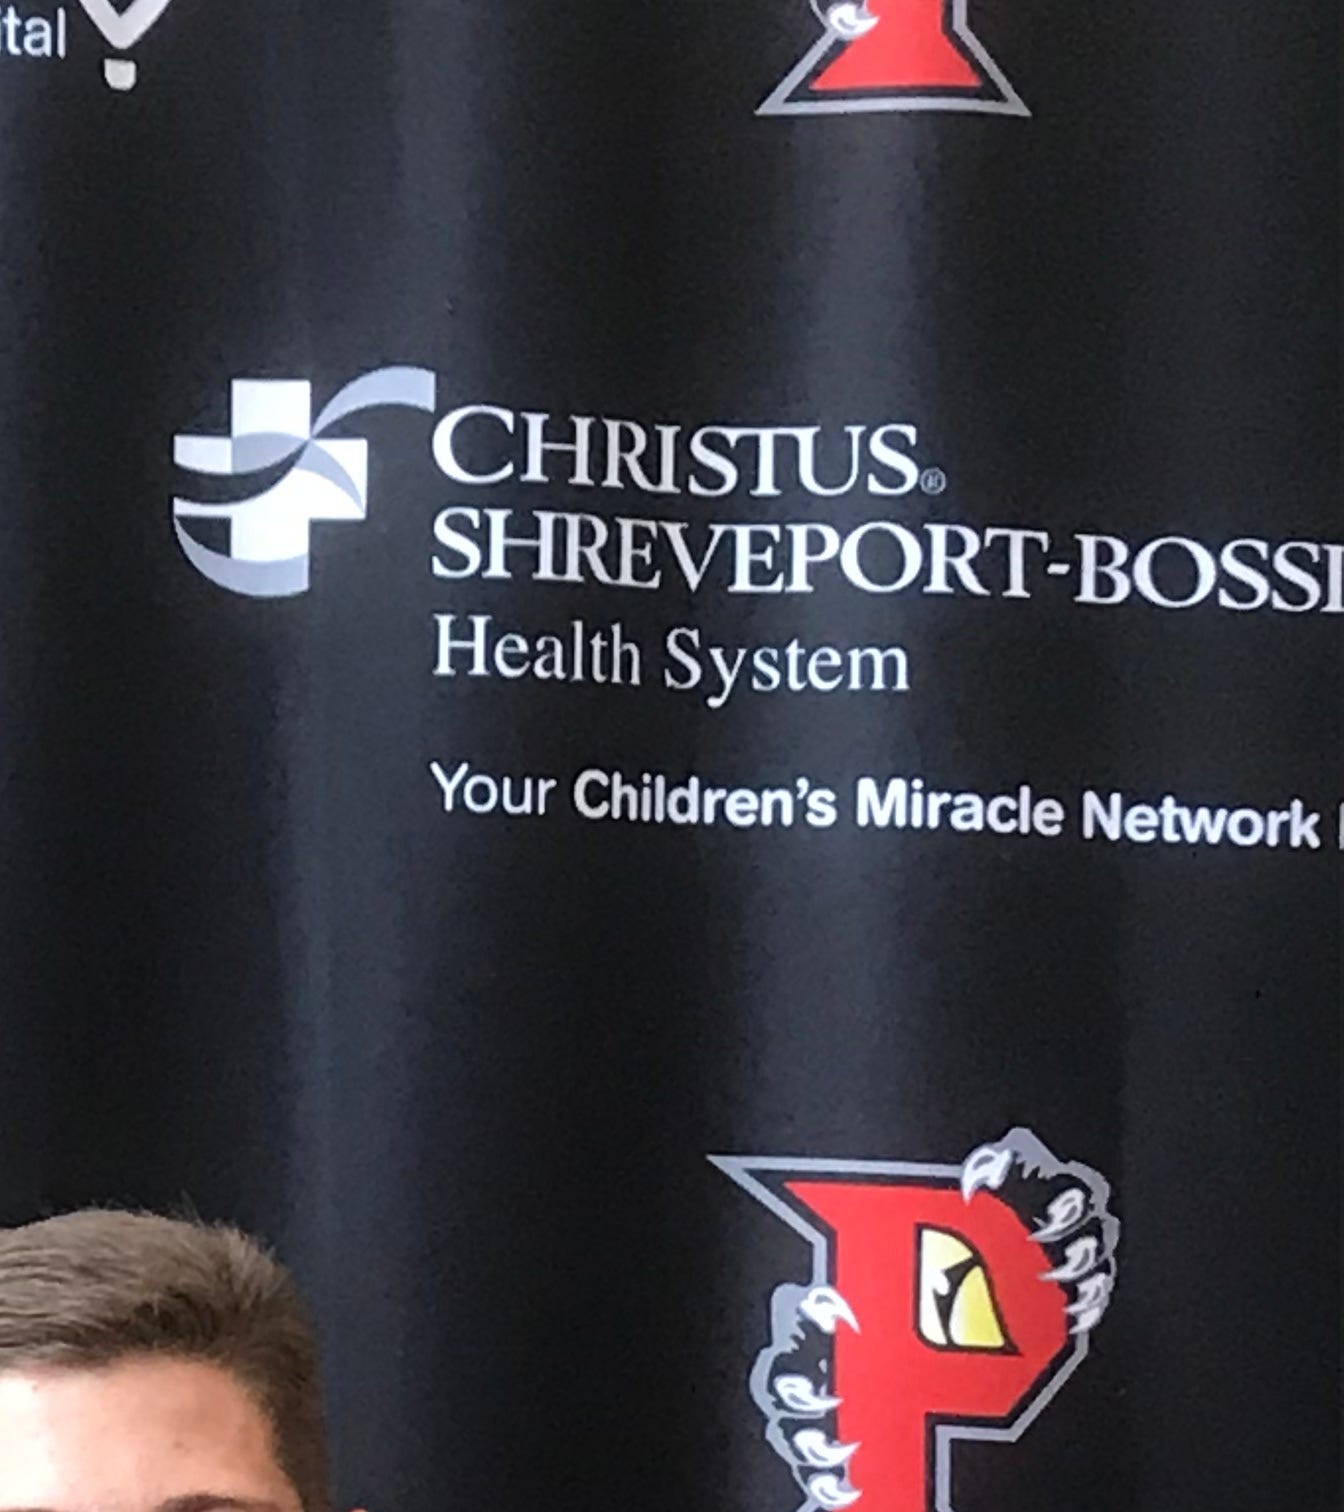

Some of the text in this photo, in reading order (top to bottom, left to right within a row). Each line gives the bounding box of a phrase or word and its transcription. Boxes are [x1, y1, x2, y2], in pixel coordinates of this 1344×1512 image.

[431, 613, 911, 709] Health System
[429, 760, 558, 816] Your
[572, 768, 839, 828] Children's
[856, 776, 1065, 836] Miracle
[1082, 790, 1321, 850] Network
